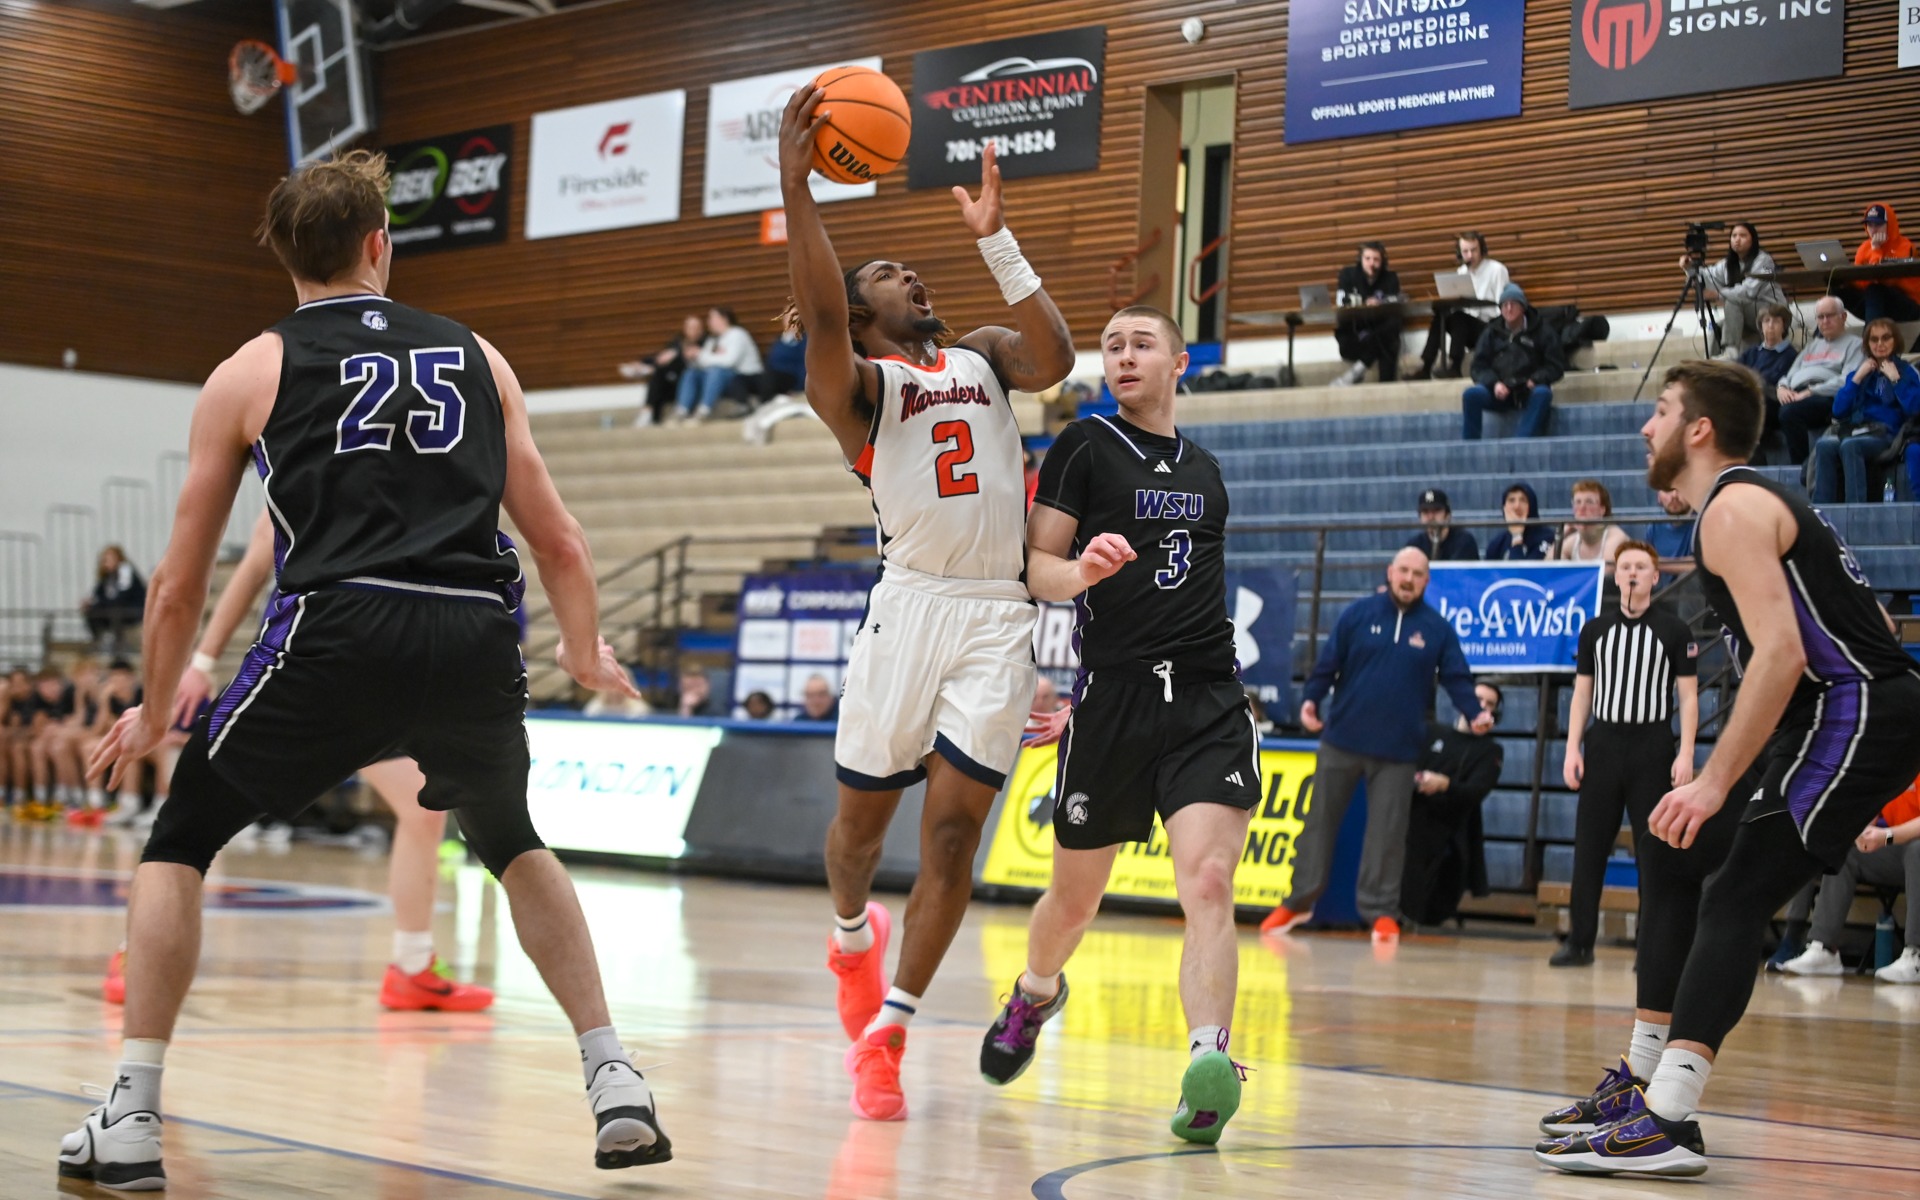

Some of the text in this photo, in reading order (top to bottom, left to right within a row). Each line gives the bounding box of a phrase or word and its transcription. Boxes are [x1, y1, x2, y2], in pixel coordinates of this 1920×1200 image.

[1340, 11, 1471, 44] ORTHOPEDICS
[1668, 6, 1767, 36] SIGNS,
[1779, 0, 1831, 20] INC
[1321, 24, 1490, 62] SPORTS MEDICINE
[944, 69, 1095, 109] CENTENNIAL
[951, 100, 1027, 122] COLLISION
[1028, 96, 1041, 113] &
[1043, 91, 1087, 111] PAINT
[1311, 84, 1496, 121] OFFICIAL SPORTS MEDICINE PARTNER
[558, 166, 649, 197] Fireside
[334, 346, 467, 454] 25
[901, 377, 991, 423] Marauders
[931, 418, 980, 499] 2
[1135, 488, 1205, 522] WSU
[1154, 529, 1193, 590] 3
[1486, 642, 1527, 657] DAKOTA
